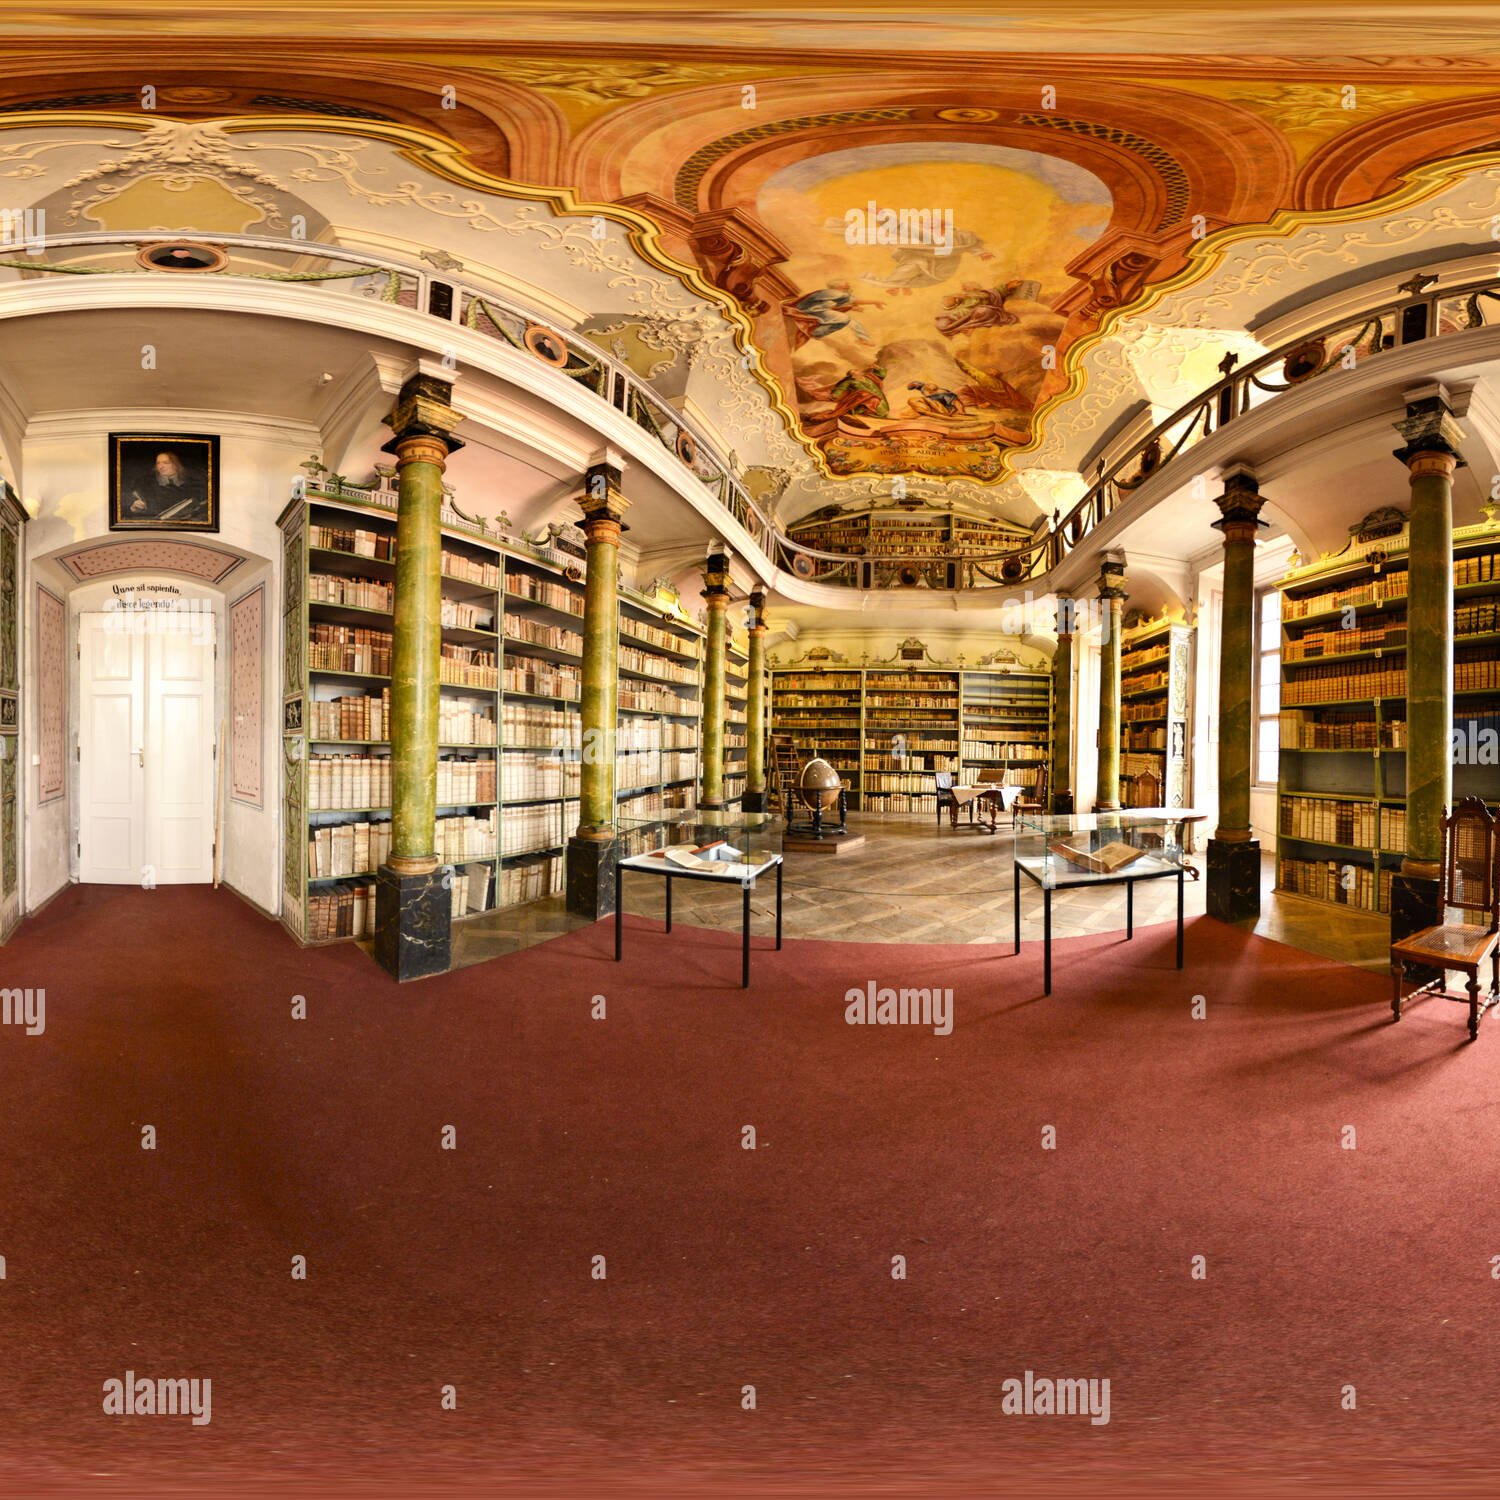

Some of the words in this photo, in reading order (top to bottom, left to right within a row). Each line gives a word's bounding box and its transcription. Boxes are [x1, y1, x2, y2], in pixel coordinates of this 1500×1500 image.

[1345, 55, 1492, 68] VOS
[112, 583, 135, 595] Quae
[136, 583, 146, 592] sit
[147, 584, 182, 596] sapientia,
